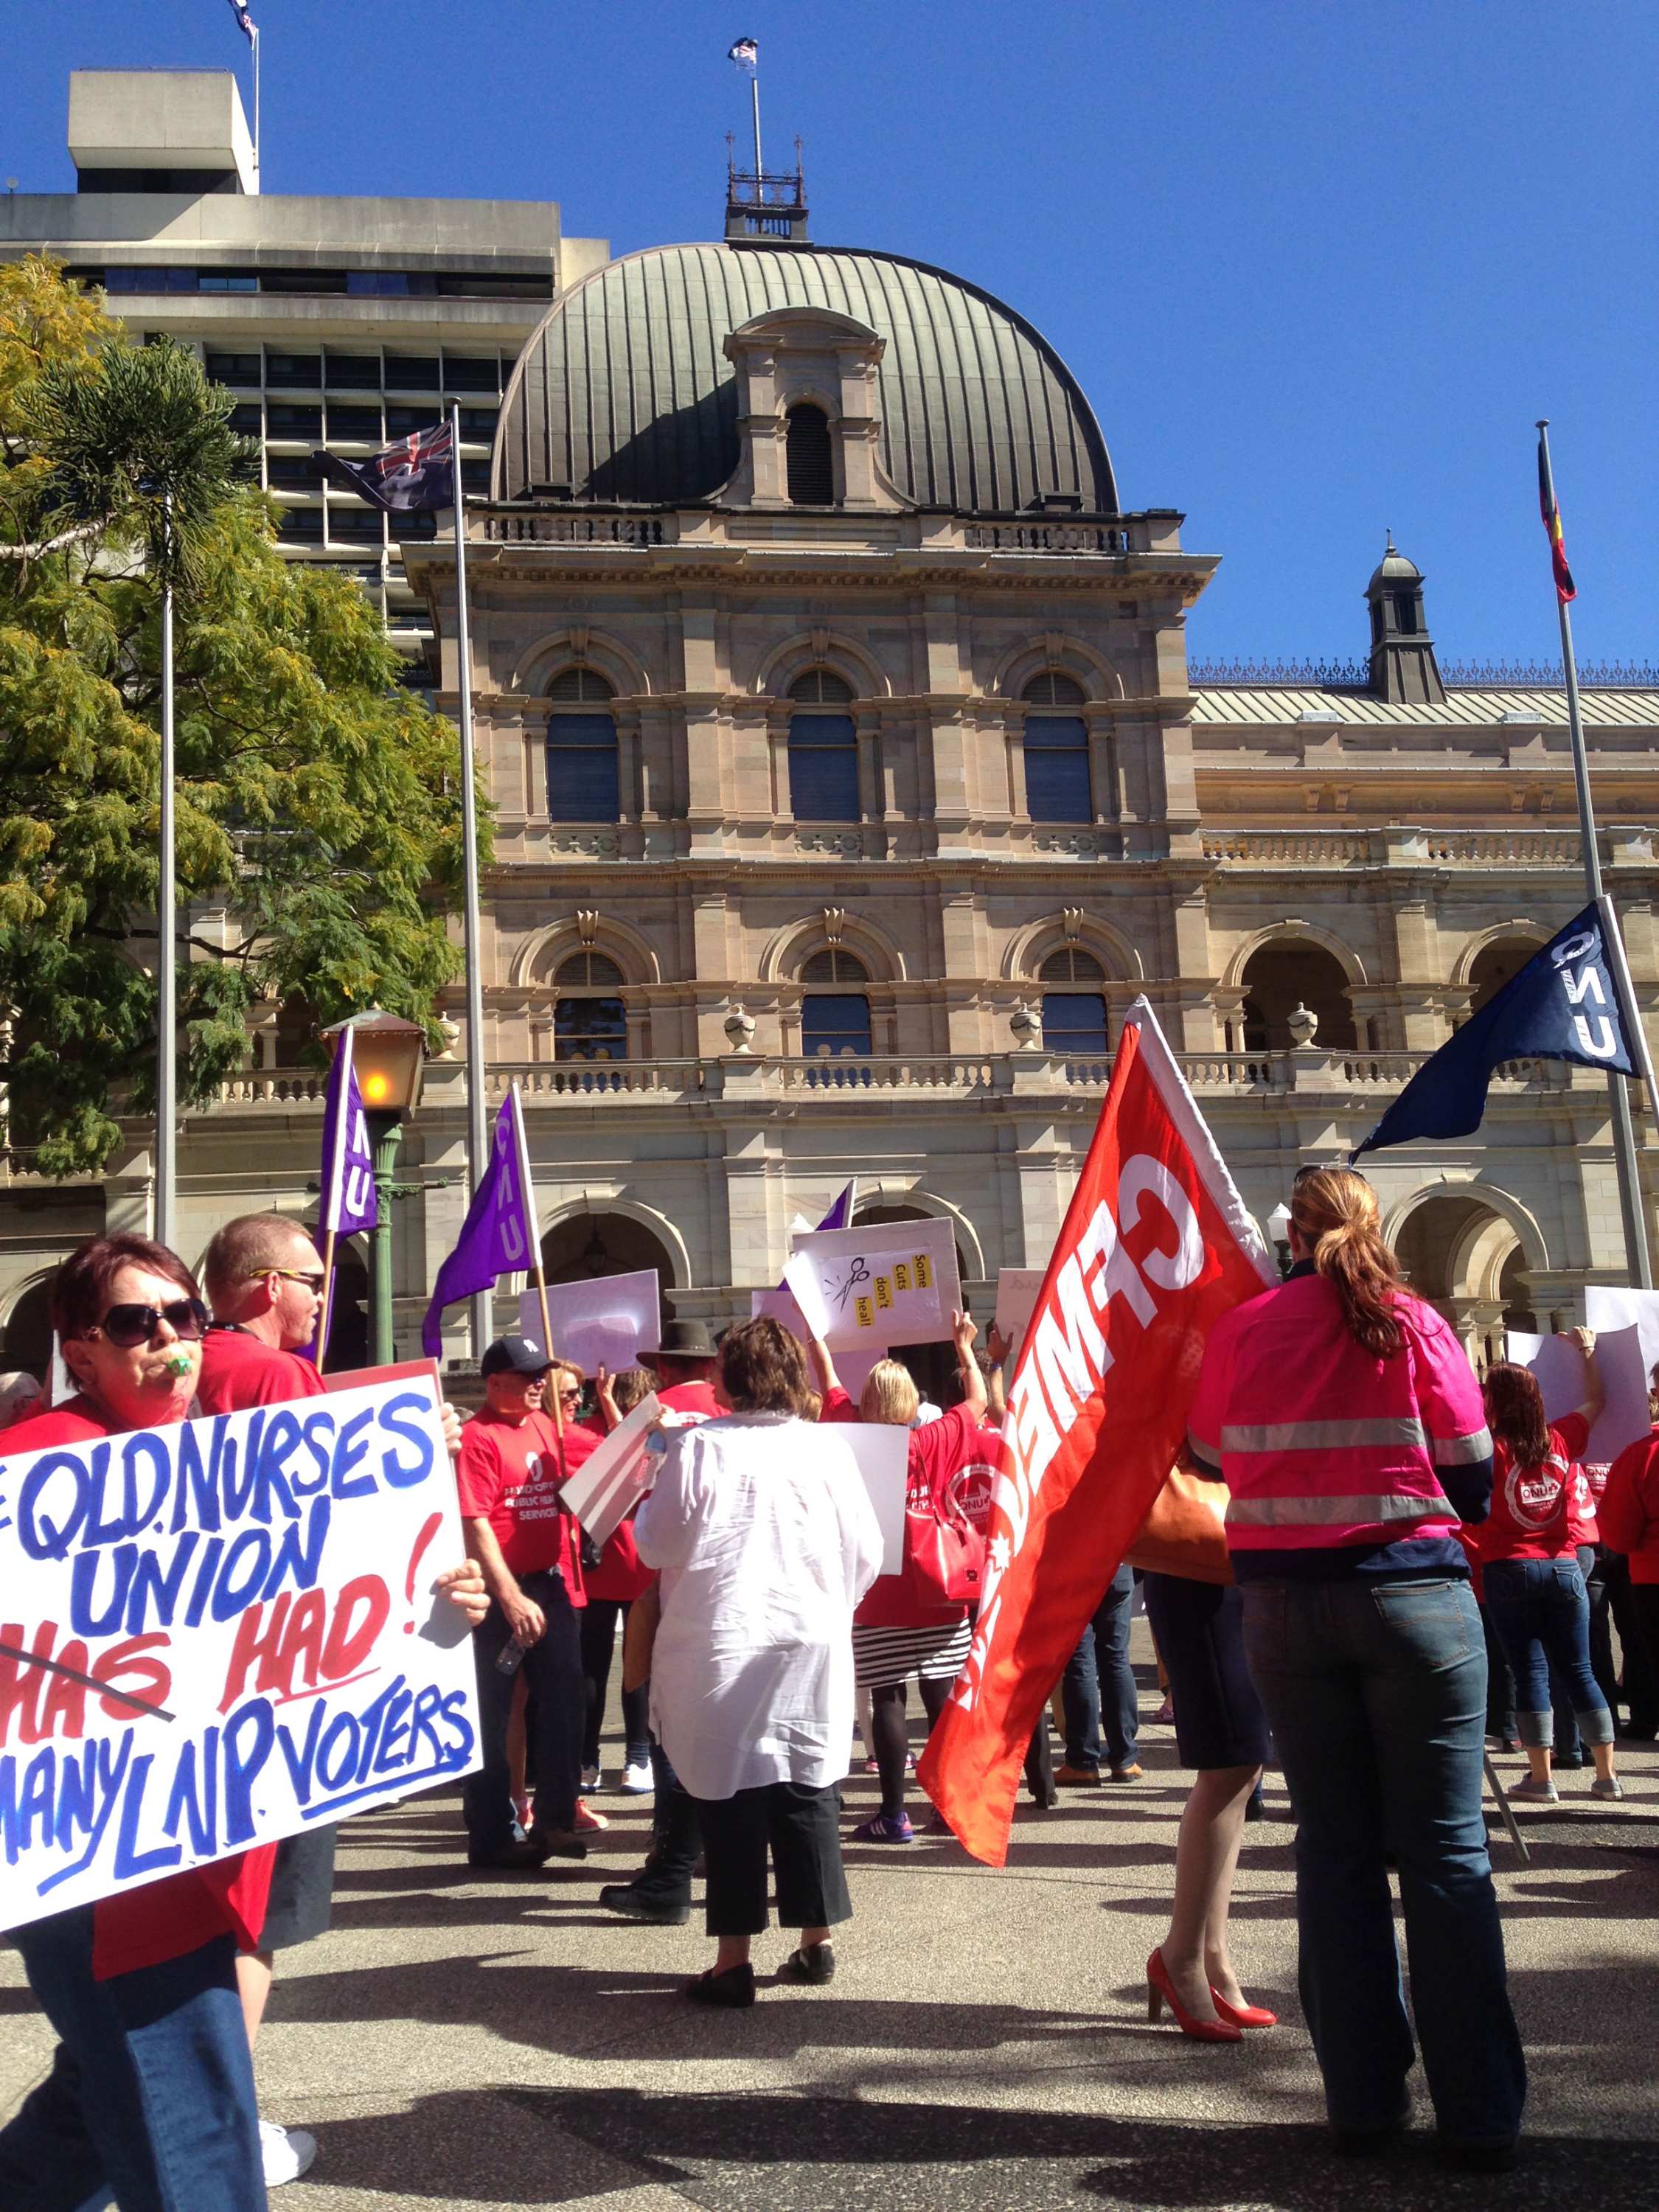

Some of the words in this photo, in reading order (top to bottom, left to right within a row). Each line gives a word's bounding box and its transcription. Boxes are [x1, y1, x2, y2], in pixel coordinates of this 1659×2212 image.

[896, 1264, 906, 1290] Cuts
[915, 1254, 926, 1288] Some
[876, 1277, 888, 1309] don't
[960, 1498, 984, 1512] QNU
[1523, 1486, 1548, 1498] QNU
[71, 1495, 330, 1638] UNION
[274, 1674, 475, 1806] VOTERS
